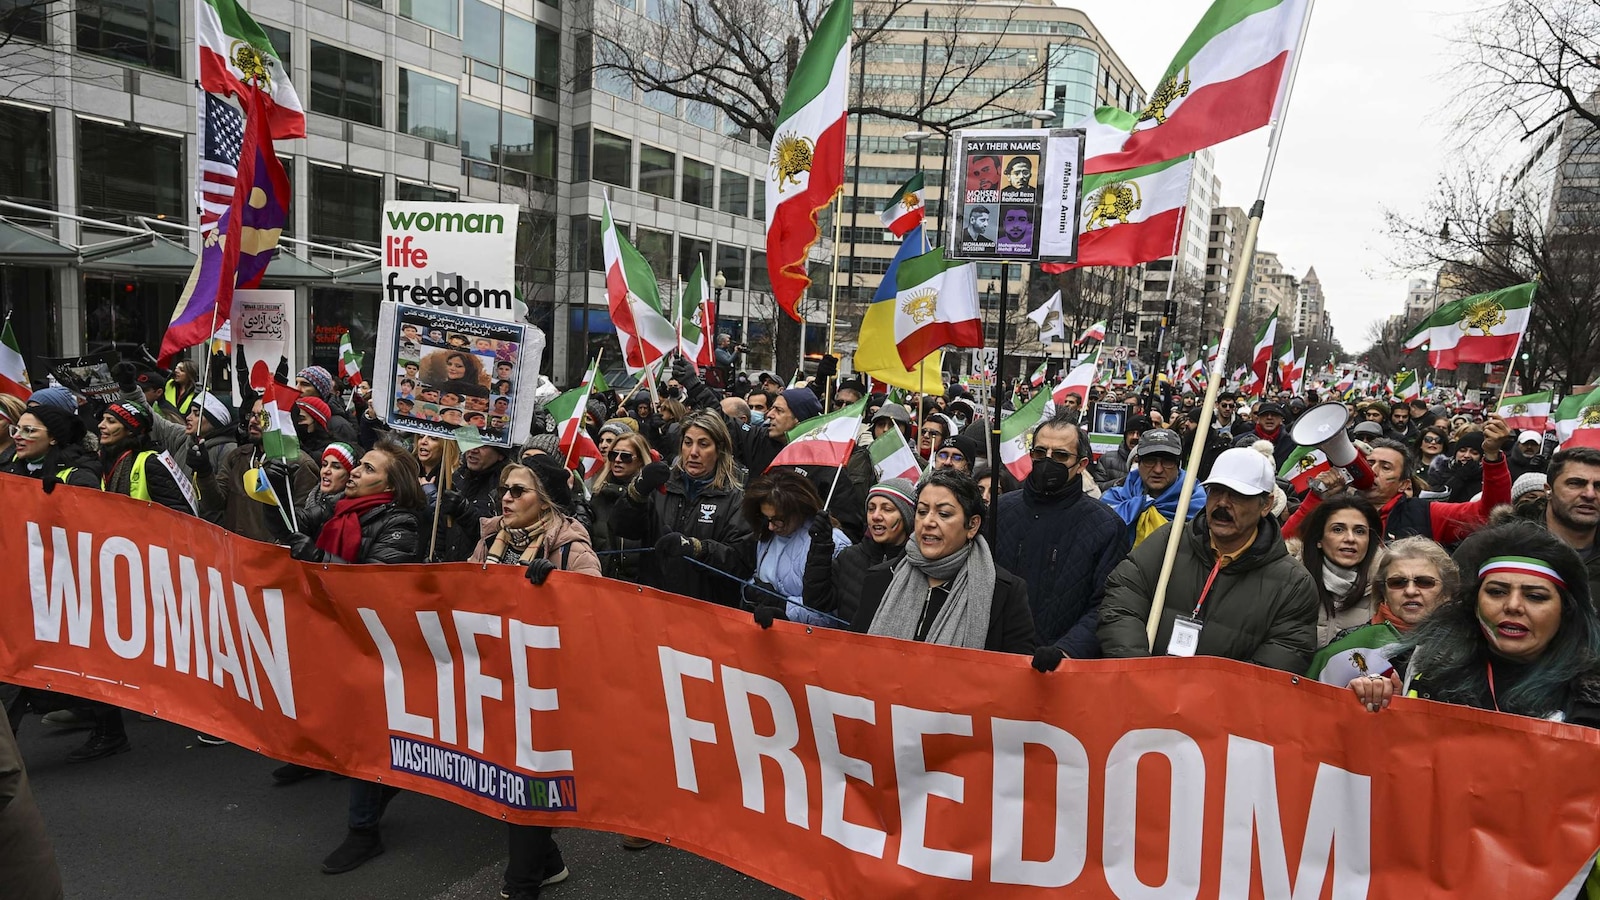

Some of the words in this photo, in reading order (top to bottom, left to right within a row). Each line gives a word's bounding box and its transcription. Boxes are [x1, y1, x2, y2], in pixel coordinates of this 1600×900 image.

[967, 142, 986, 151] SAY
[986, 142, 1008, 151] THEIR
[1009, 142, 1041, 151] NAMES
[1062, 161, 1072, 201] #Mahsa
[386, 211, 504, 234] woman
[1059, 205, 1069, 234] Amini
[386, 235, 428, 269] life
[386, 272, 512, 310] freedom
[26, 521, 297, 720] WOMAN
[357, 607, 574, 772] LIFE
[390, 737, 476, 790] WASHINGTON
[478, 762, 496, 797] DC
[499, 769, 527, 807] FOR
[529, 779, 575, 808] IRAN
[658, 645, 1372, 900] FREEDOM
